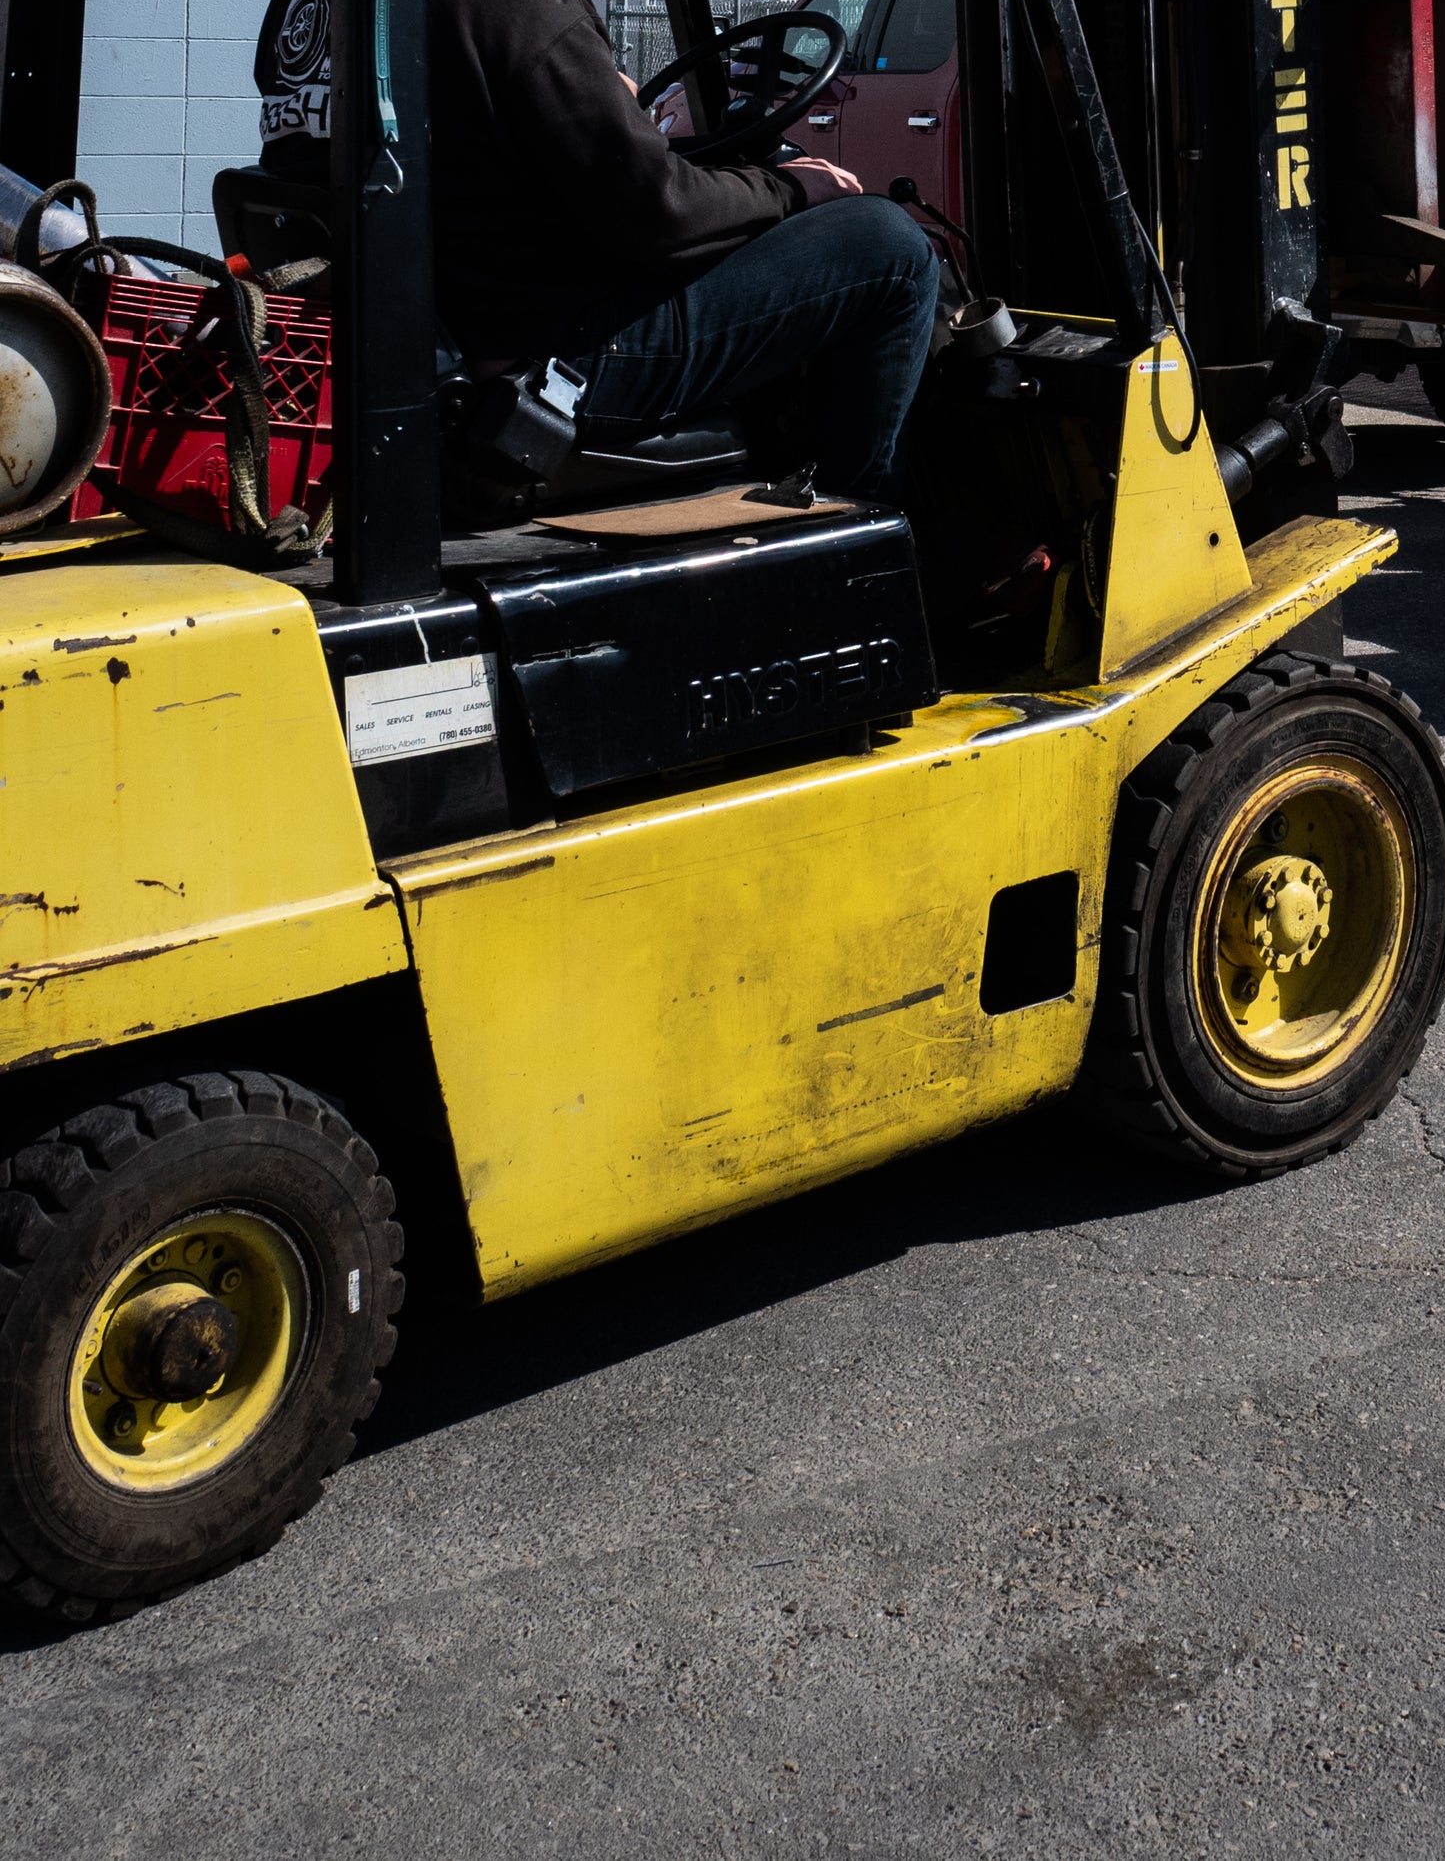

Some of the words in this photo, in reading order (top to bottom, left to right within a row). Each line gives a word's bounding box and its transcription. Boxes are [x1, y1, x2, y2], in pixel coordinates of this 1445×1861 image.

[687, 637, 903, 737] HYSTER
[355, 721, 375, 732] SALES
[386, 714, 414, 726] SERVICE
[425, 707, 452, 719] RENTALS
[463, 700, 491, 712] LEASING
[398, 737, 426, 749] Alberta
[439, 730, 457, 743] (780)
[458, 723, 492, 737] 455-0380
